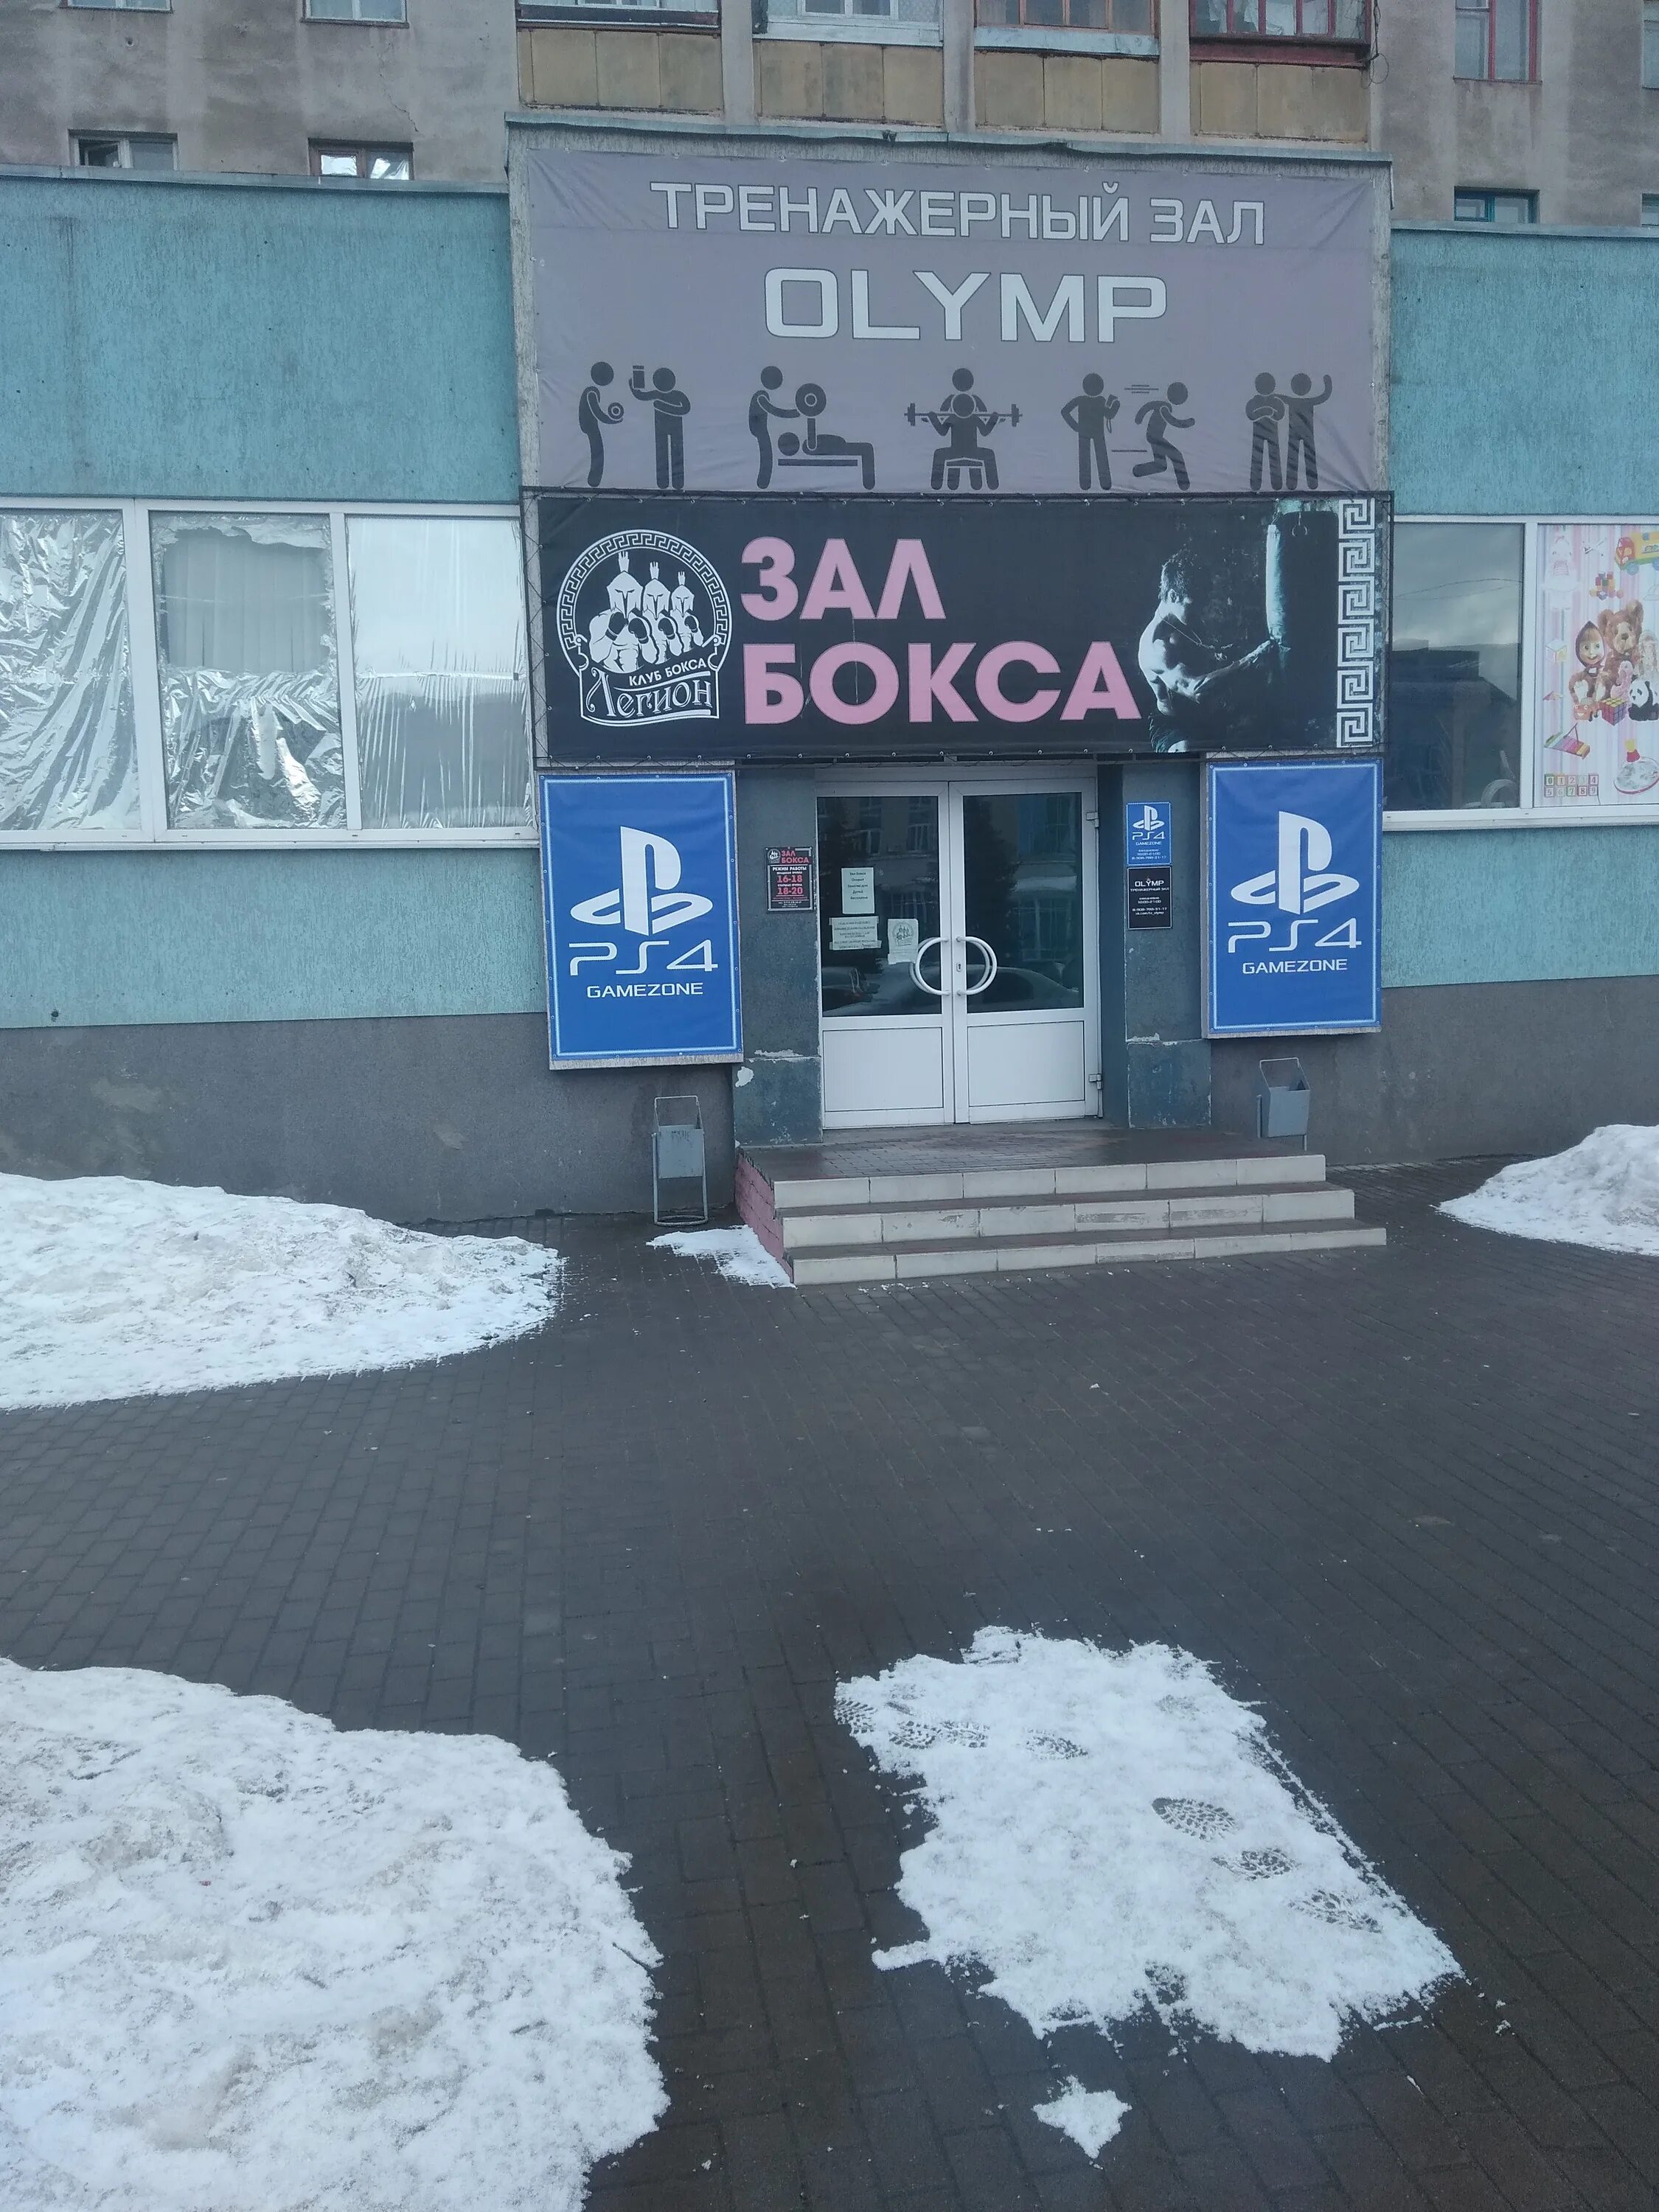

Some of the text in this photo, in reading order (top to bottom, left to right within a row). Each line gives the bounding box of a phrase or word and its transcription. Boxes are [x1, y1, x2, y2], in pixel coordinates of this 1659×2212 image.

[650, 181, 1265, 246] ТРЕНАЖЕРНЫЙ ЗАЛ
[764, 268, 1167, 344] OLYMP
[740, 536, 946, 621] ЗАЛ
[629, 658, 707, 686] КЛУБ БОКСА
[743, 641, 1142, 725] БОКСА
[1133, 831, 1166, 841] PS4
[777, 874, 803, 883] 16-18
[777, 887, 803, 895] 18-20
[1228, 917, 1363, 953] PS4
[568, 939, 718, 976] PS4
[1242, 959, 1348, 974] GAMEZONE
[587, 982, 703, 998] GAMEZONE
